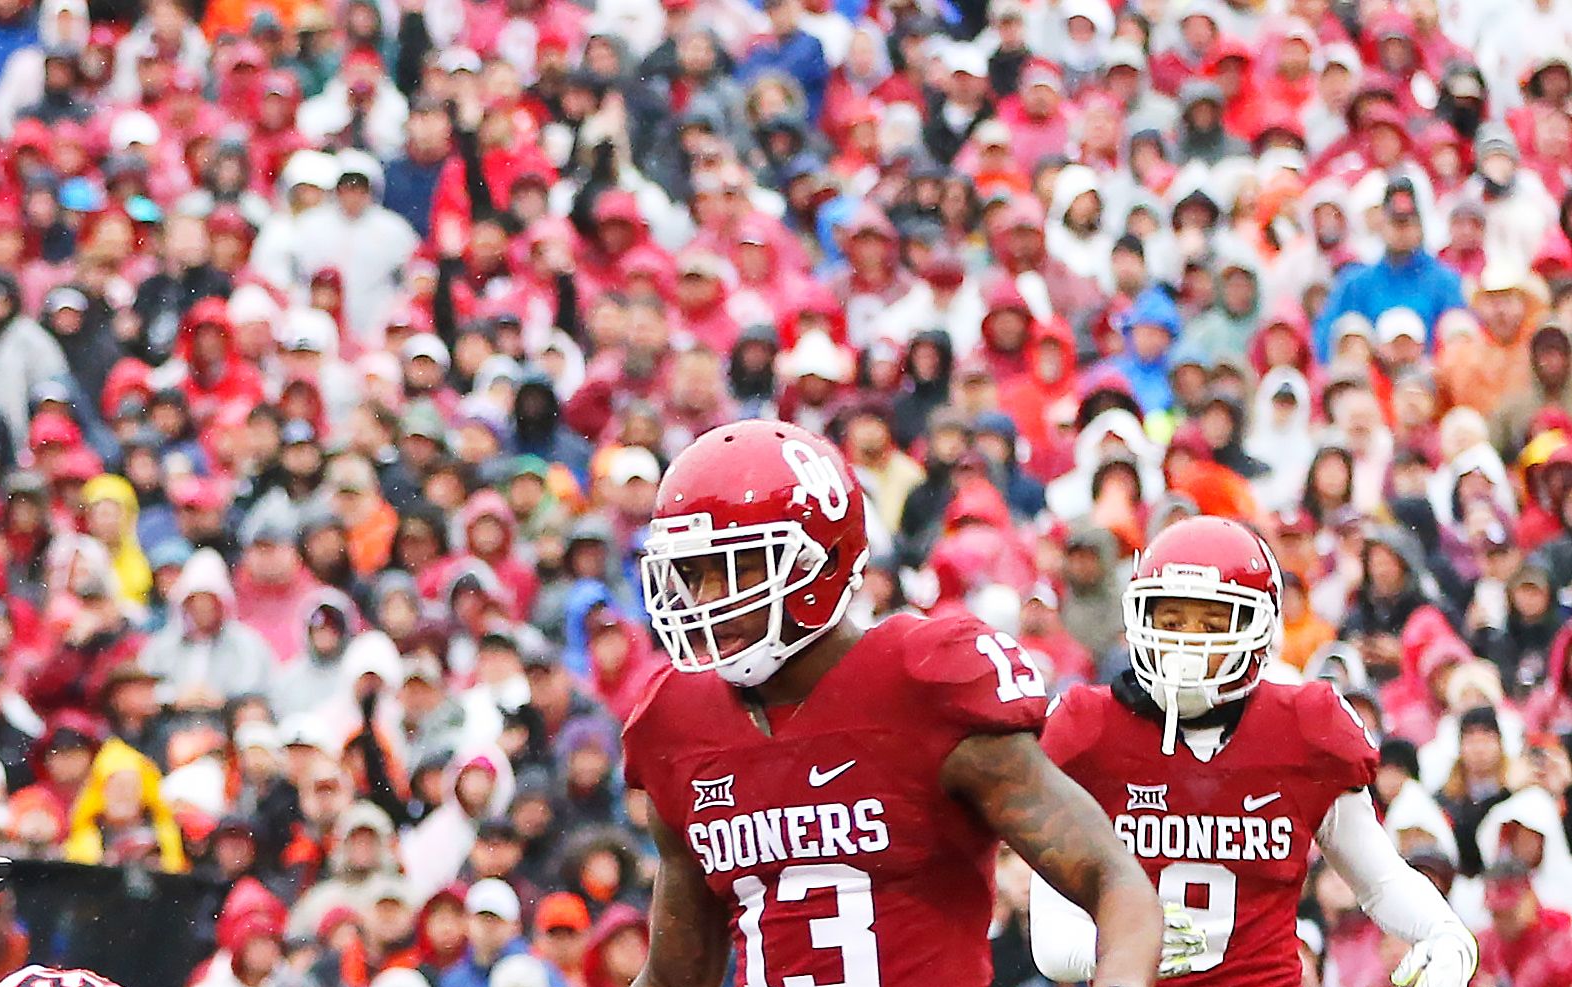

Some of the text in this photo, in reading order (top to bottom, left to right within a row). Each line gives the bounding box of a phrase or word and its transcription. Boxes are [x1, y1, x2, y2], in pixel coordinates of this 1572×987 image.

[976, 632, 1048, 702] 13
[687, 798, 890, 875] SOONERS
[1114, 814, 1293, 860] SOONERS
